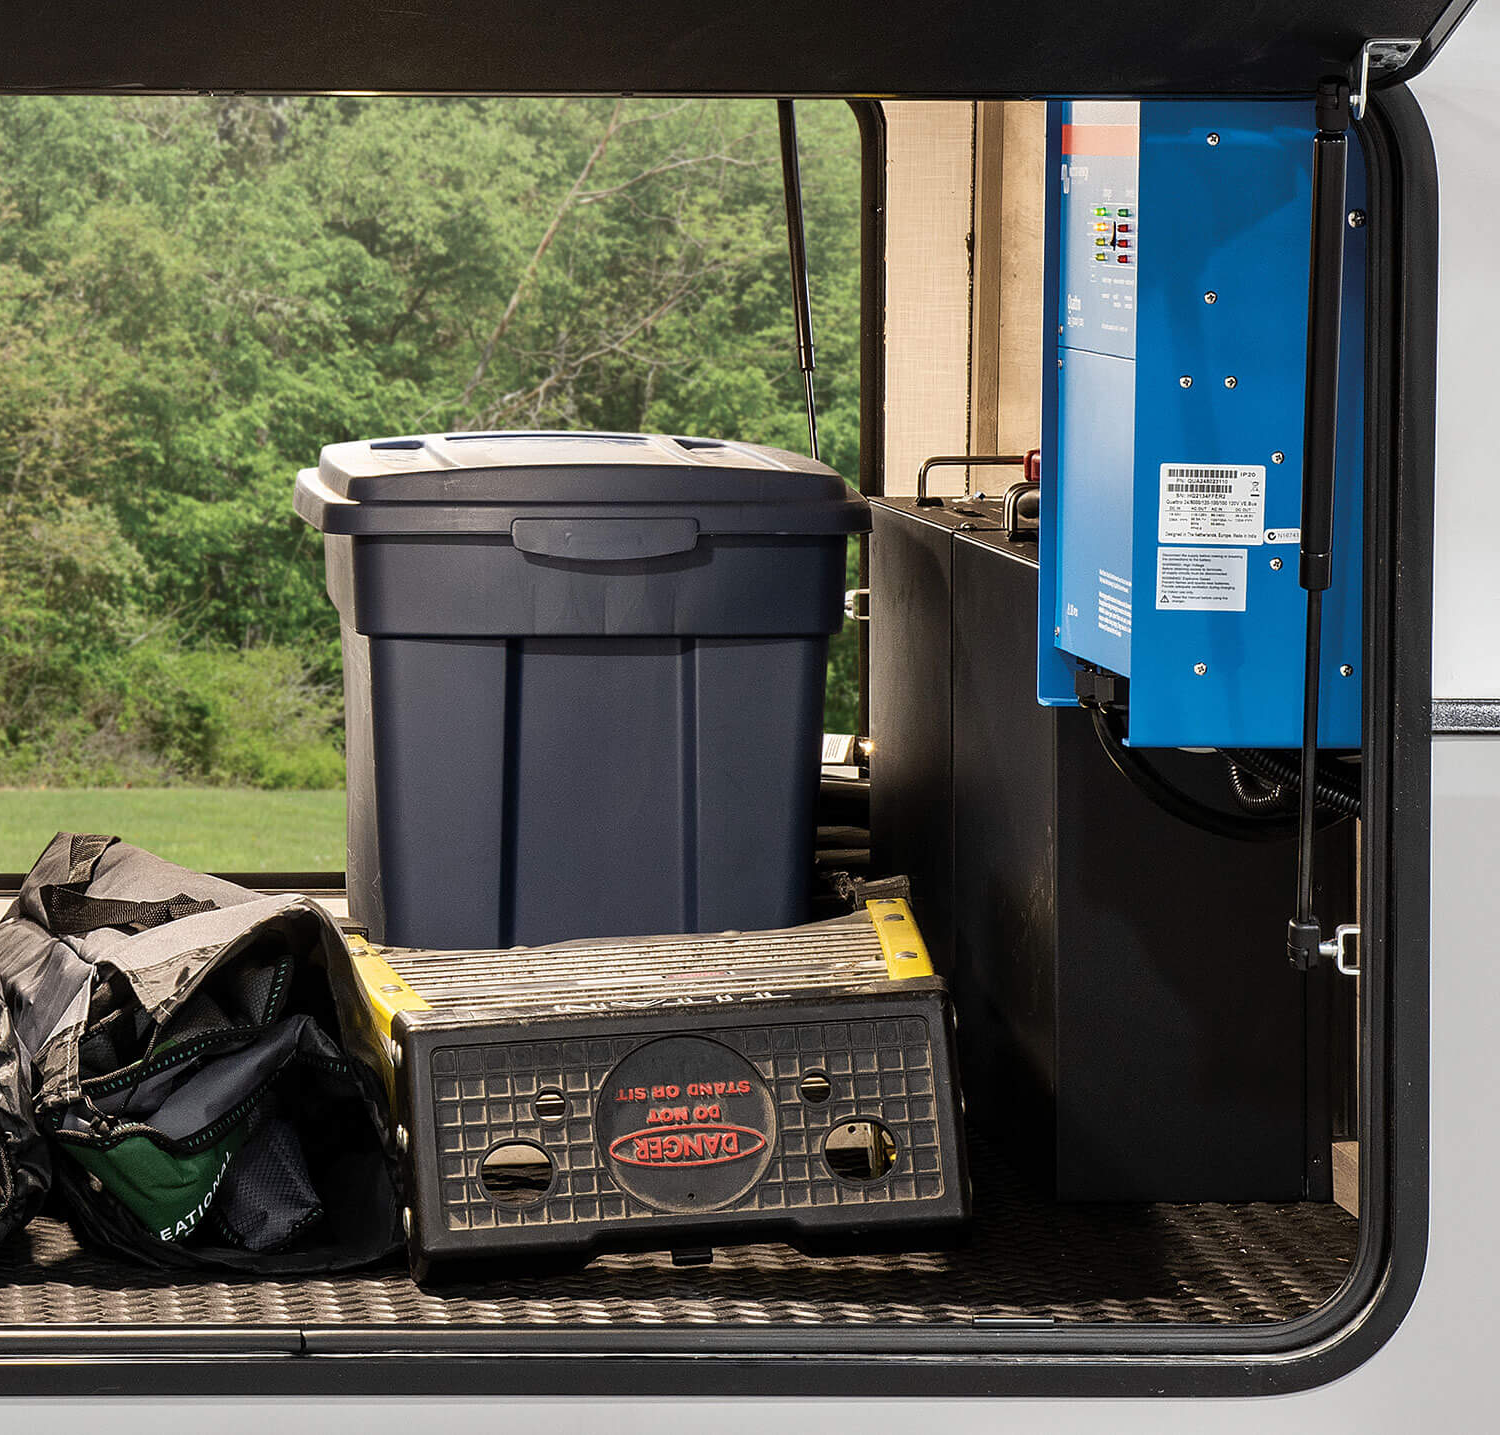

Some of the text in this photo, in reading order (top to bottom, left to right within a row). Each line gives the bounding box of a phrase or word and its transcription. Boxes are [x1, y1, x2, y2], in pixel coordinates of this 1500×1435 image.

[616, 1080, 751, 1101] STAND OR SIT
[647, 1104, 721, 1123] DO NOT
[633, 1132, 739, 1160] DANGER
